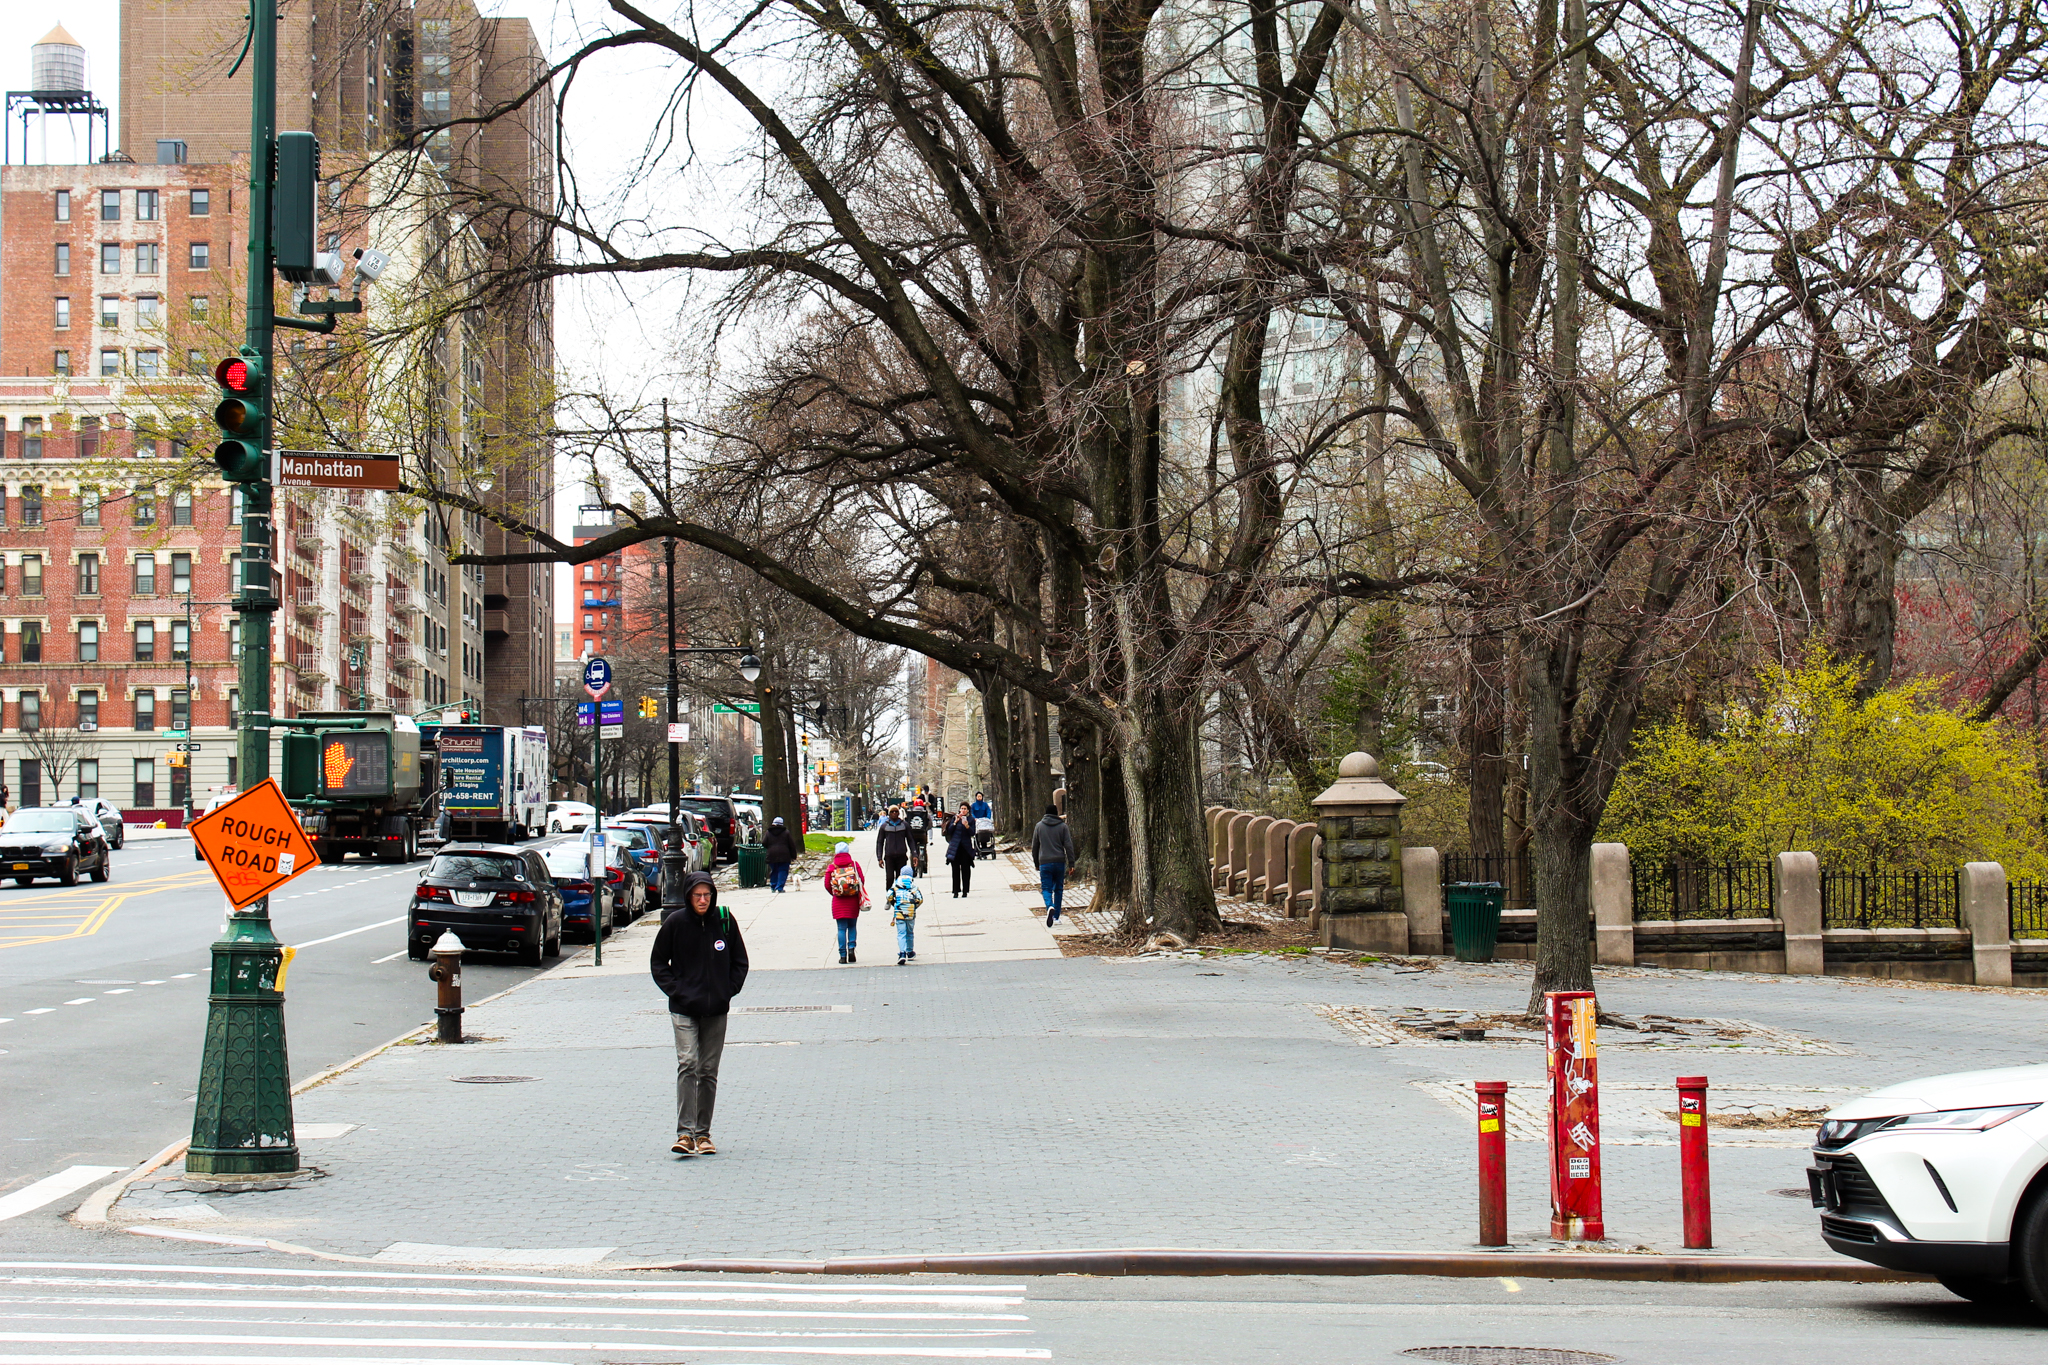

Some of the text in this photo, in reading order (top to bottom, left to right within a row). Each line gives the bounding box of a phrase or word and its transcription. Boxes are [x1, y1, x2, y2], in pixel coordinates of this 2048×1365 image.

[282, 458, 363, 478] Manhattan
[282, 477, 312, 486] Avenue
[441, 737, 482, 746] Churchill
[441, 757, 489, 765] urchillcorp.com
[221, 816, 292, 849] ROUGH
[221, 846, 277, 873] ROAD
